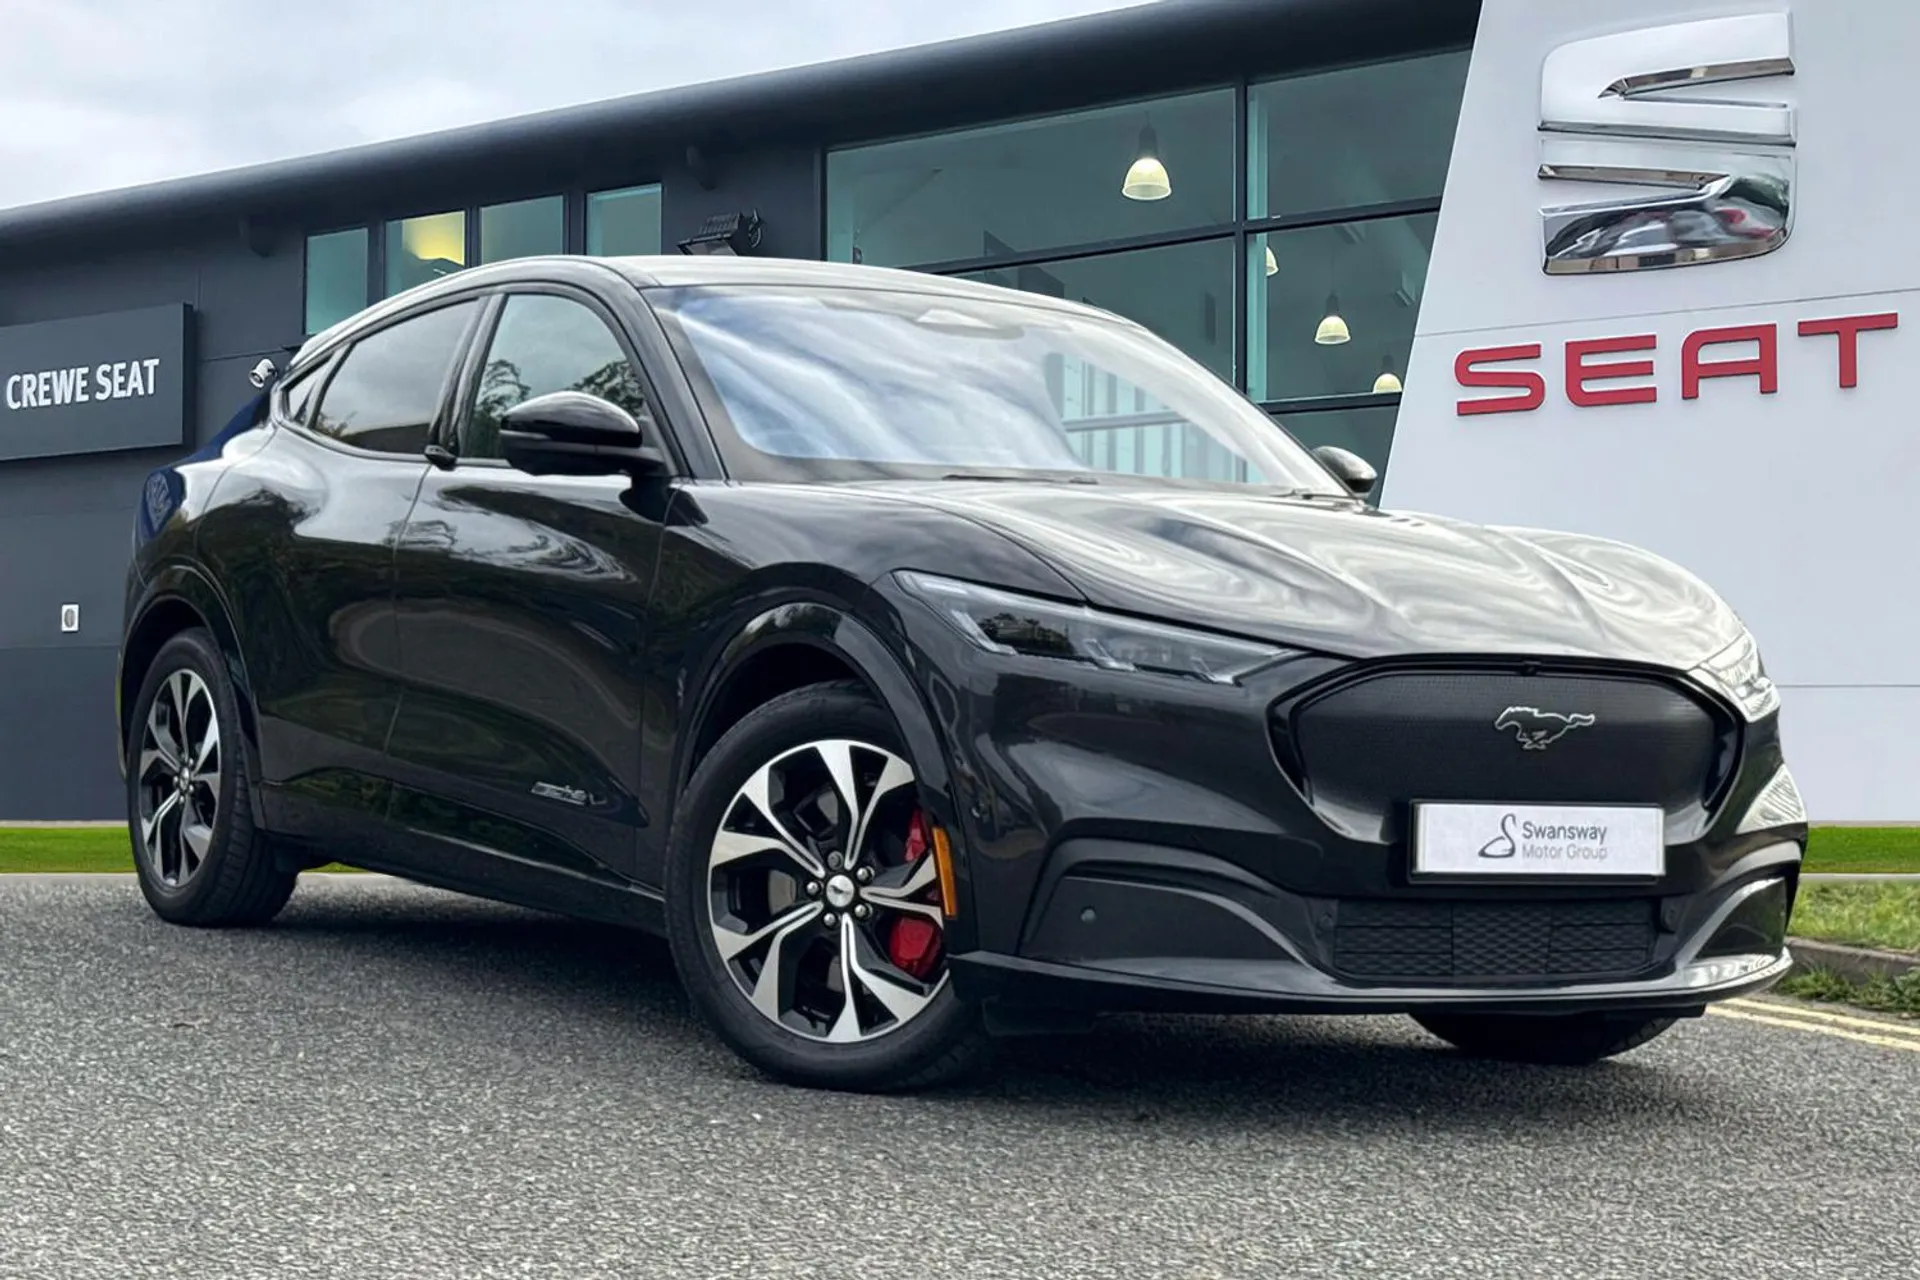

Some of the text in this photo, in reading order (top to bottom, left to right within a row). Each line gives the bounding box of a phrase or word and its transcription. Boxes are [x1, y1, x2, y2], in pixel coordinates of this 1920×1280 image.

[1455, 313, 1897, 416] SEAT
[6, 358, 160, 409] CREWE SEAT
[1522, 821, 1607, 845] Swansway
[1522, 843, 1607, 861] Motor Group
